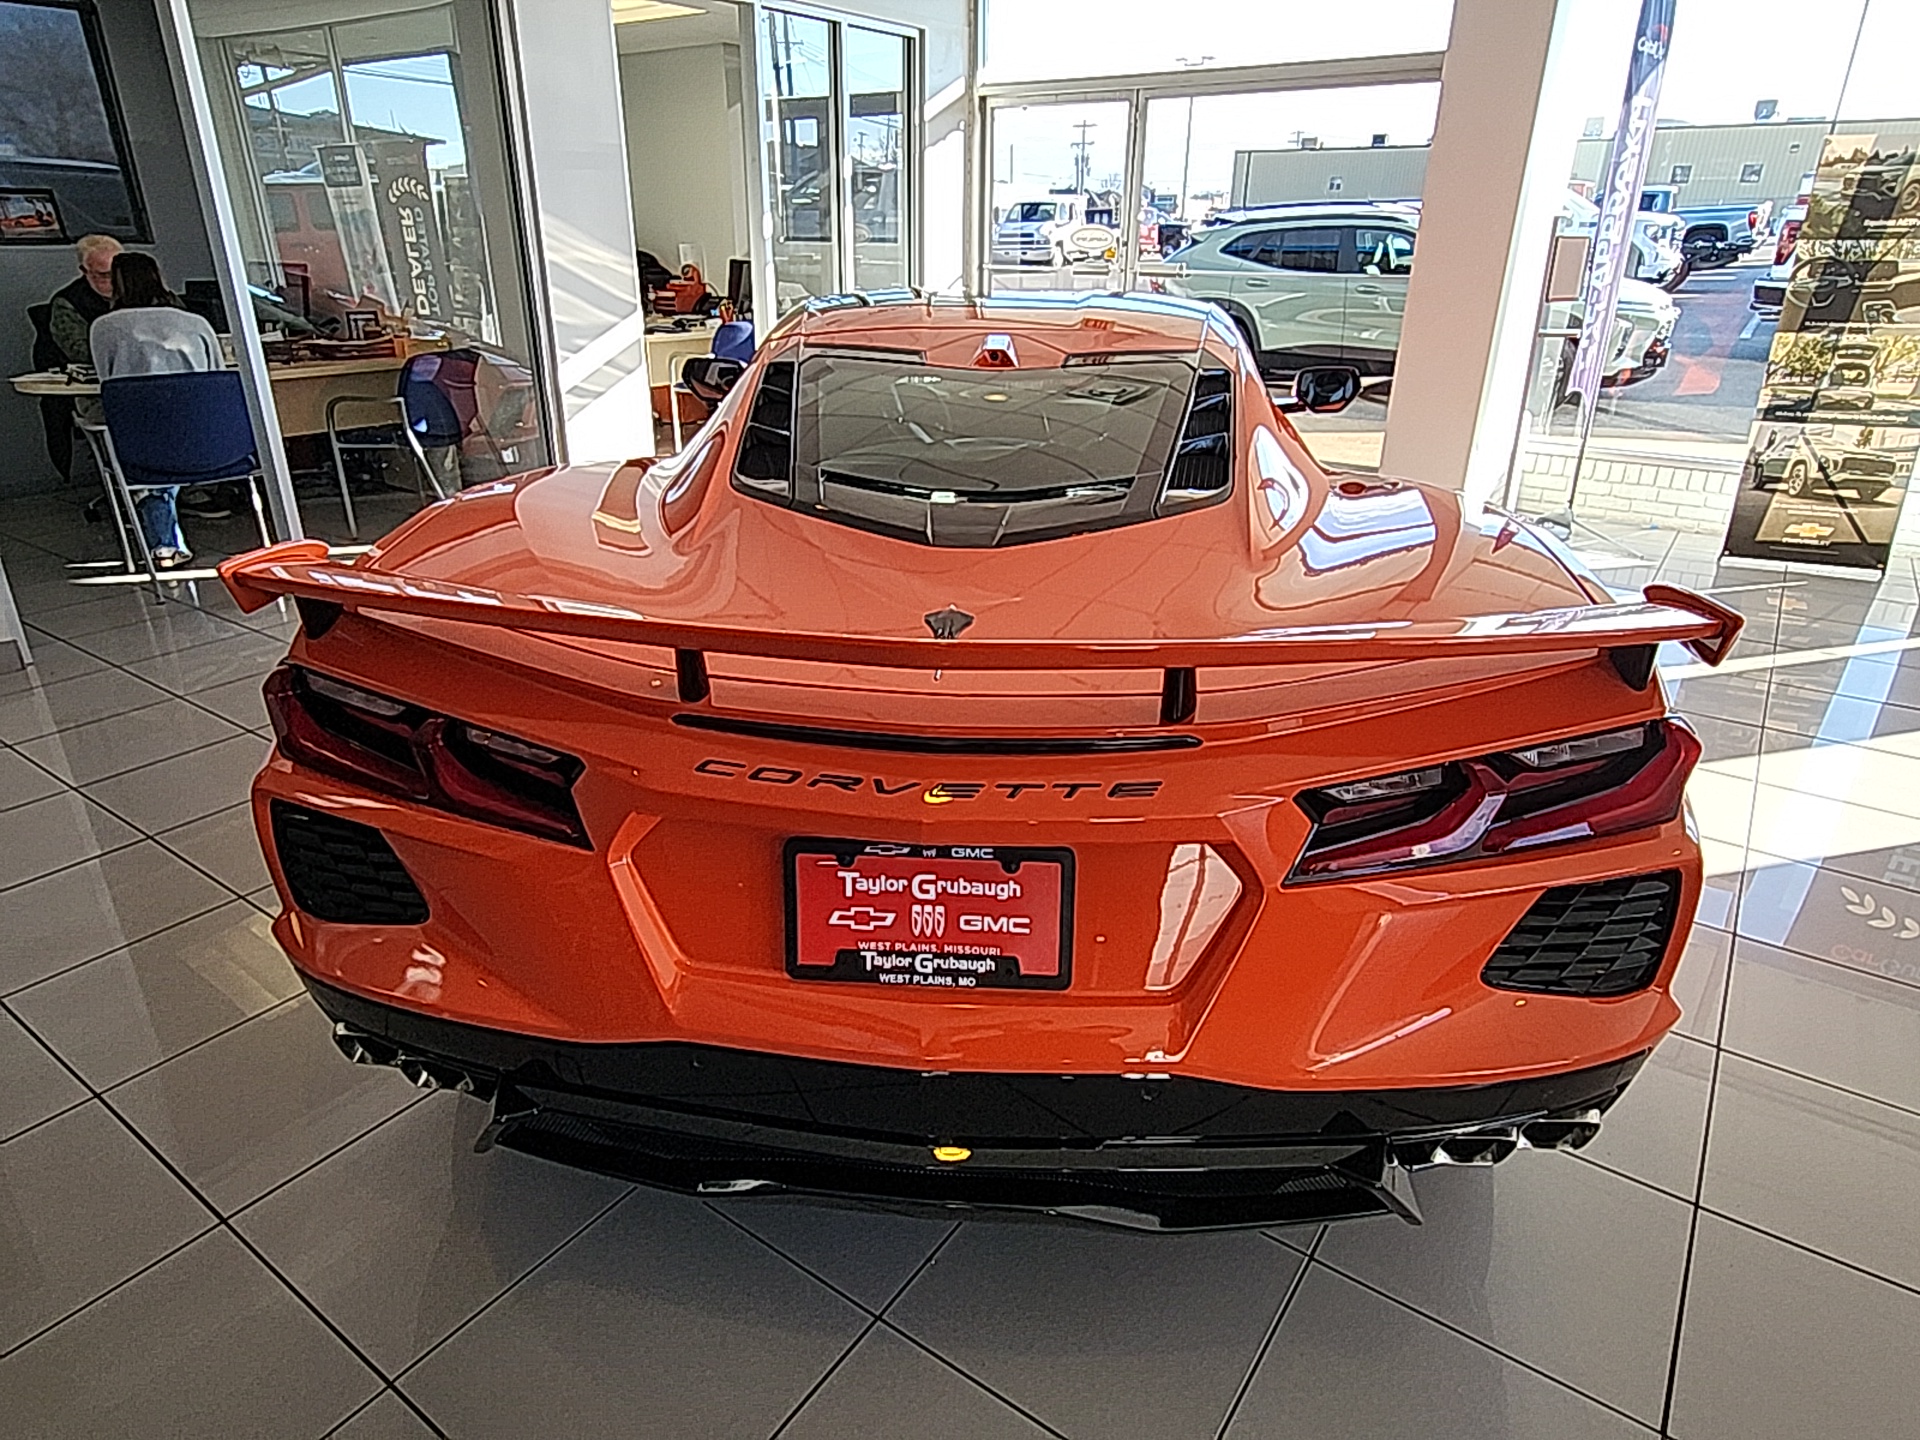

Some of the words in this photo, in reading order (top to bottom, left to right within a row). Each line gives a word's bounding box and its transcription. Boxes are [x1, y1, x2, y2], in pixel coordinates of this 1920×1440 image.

[694, 758, 1163, 799] CORVETTE
[951, 847, 995, 859] GMC
[837, 871, 909, 898] Taylor
[911, 874, 1022, 900] Grubaugh
[959, 915, 1031, 934] GMC
[857, 941, 892, 951] WEST
[943, 944, 1001, 956] MISSOURI
[860, 951, 913, 972] Taylor
[914, 953, 996, 973] Grubaugh
[879, 973, 911, 984] WEST
[912, 974, 956, 988] PLAINS,
[958, 976, 976, 987] MO
